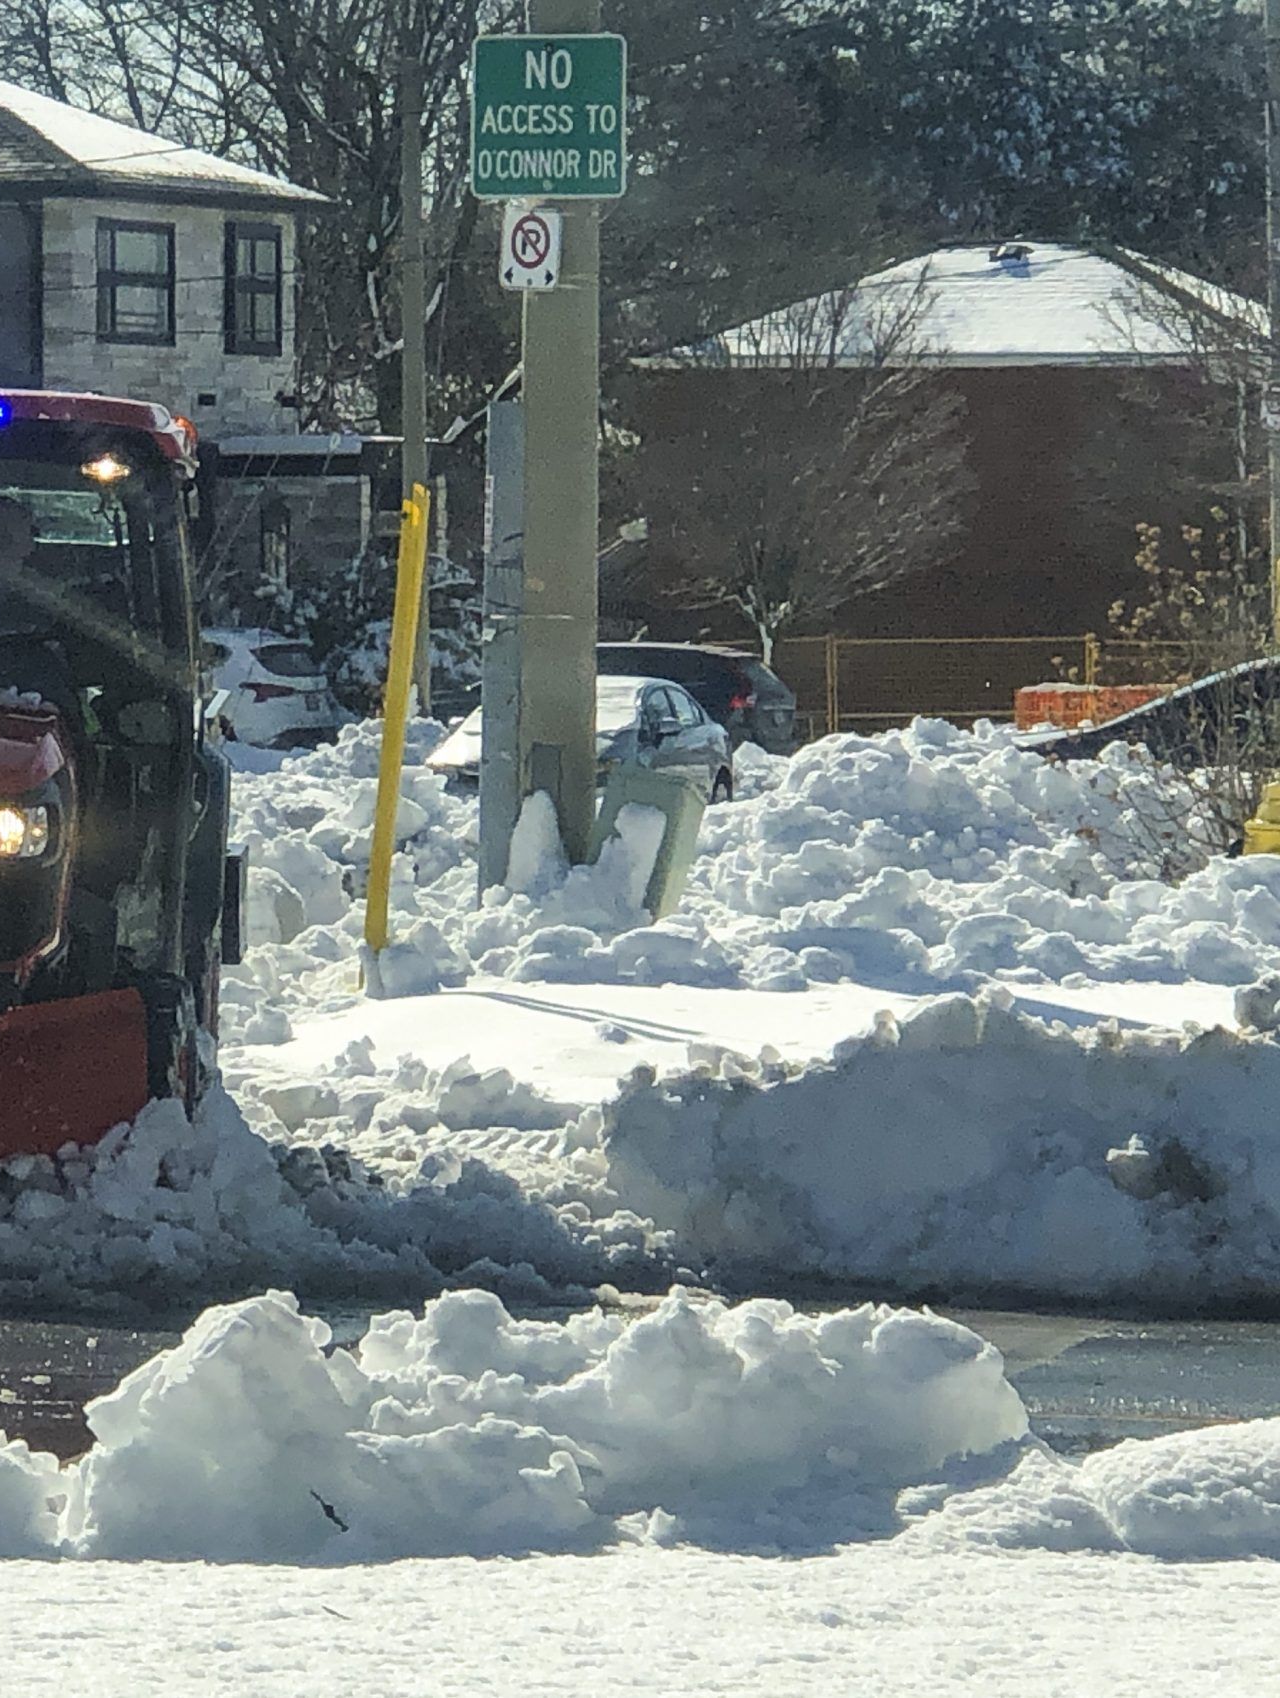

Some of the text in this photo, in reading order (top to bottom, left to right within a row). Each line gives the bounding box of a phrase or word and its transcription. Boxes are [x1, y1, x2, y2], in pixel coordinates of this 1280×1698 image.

[525, 49, 573, 89] NO
[481, 104, 617, 134] ACCESS TO
[478, 149, 617, 180] O'CONNOR DR
